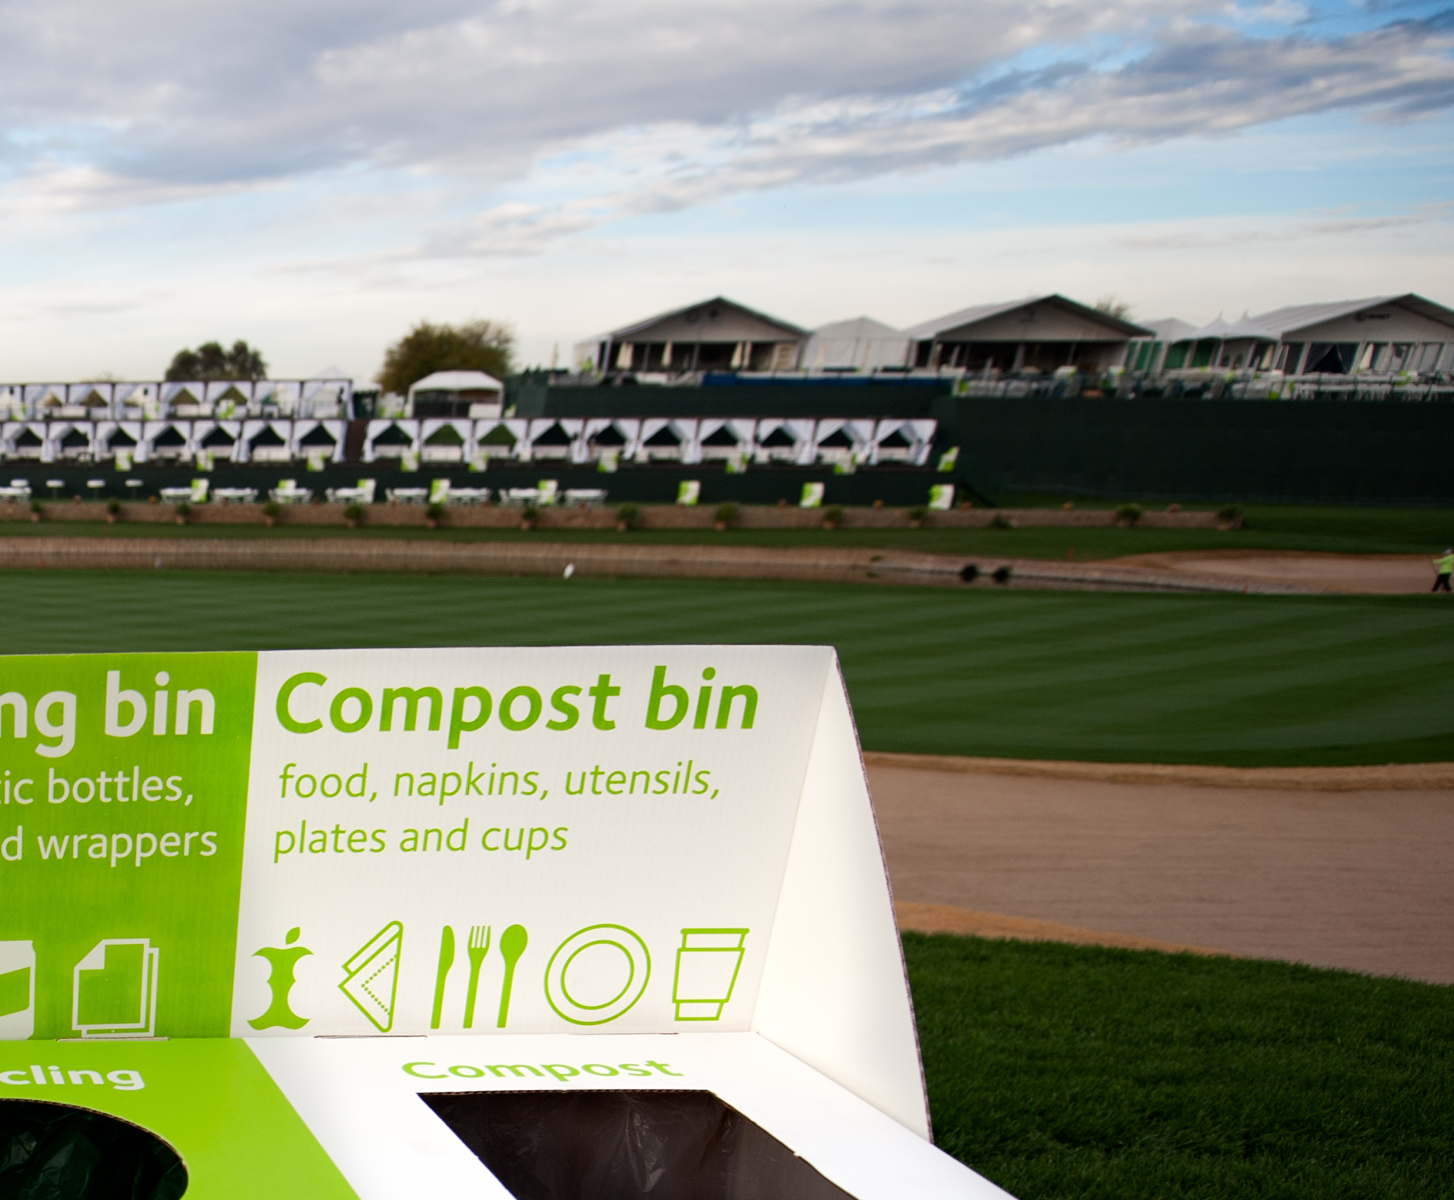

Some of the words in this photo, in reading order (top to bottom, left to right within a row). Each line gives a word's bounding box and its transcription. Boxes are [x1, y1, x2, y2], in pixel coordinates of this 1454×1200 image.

[105, 670, 215, 737] bin
[277, 672, 620, 749] Compost
[646, 666, 758, 730] bin
[49, 765, 193, 806] bottles,
[280, 763, 377, 801] food,
[395, 762, 547, 805] napkins,
[566, 760, 718, 799] utensils,
[38, 831, 217, 867] wrappers
[275, 820, 386, 863] plates
[401, 818, 468, 851] and
[483, 827, 568, 859] cups
[403, 1061, 682, 1081] Compost
